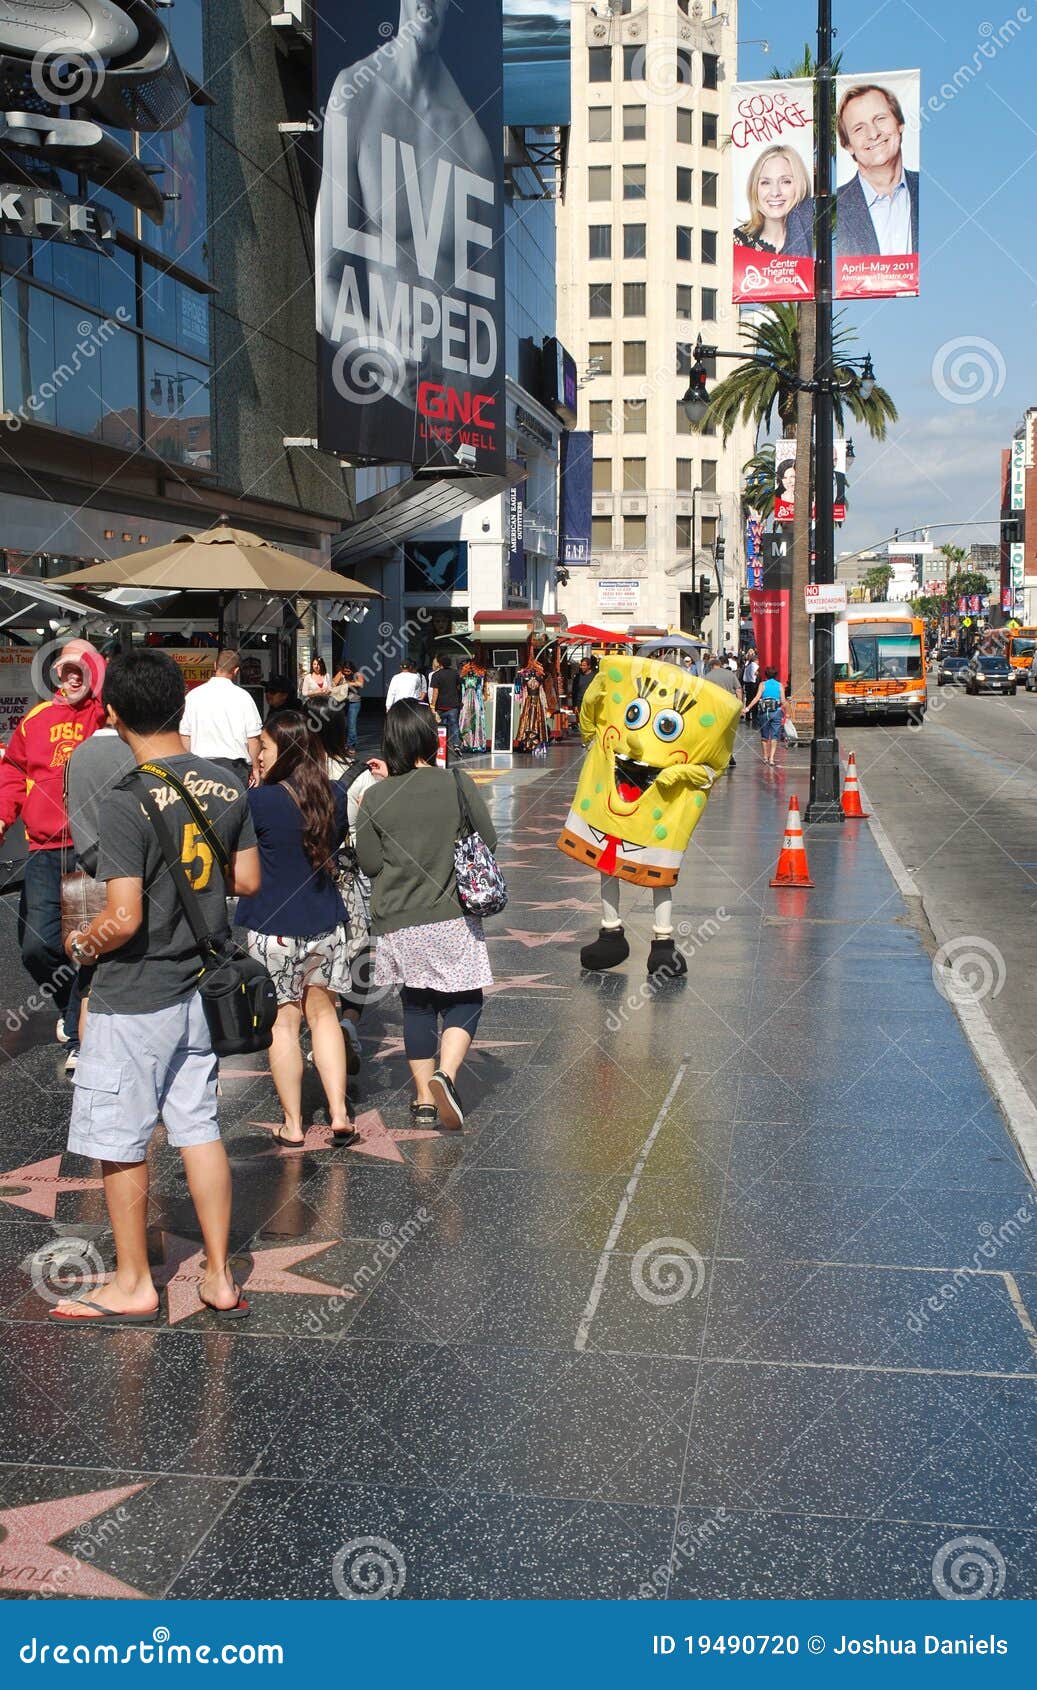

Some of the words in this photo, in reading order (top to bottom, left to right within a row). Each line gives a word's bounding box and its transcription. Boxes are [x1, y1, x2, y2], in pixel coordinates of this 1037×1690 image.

[738, 95, 774, 118] GOD
[774, 93, 787, 105] OF
[731, 102, 815, 148] CARNAGE
[0, 193, 112, 239] KLE
[332, 113, 495, 300] LIVE
[762, 267, 795, 276] Theatre
[770, 259, 799, 268] Center
[893, 262, 914, 272] 2011
[774, 275, 800, 285] Group
[331, 265, 497, 379] AMPED
[417, 381, 496, 430] GNC
[420, 424, 454, 444] LIVE
[459, 431, 497, 450] WELL
[565, 544, 584, 560] GAP
[771, 541, 787, 557] M
[751, 560, 763, 590] MUS
[806, 585, 818, 596] NO
[49, 722, 84, 743] USC
[141, 763, 167, 778] Nikon
[181, 822, 213, 890] 5
